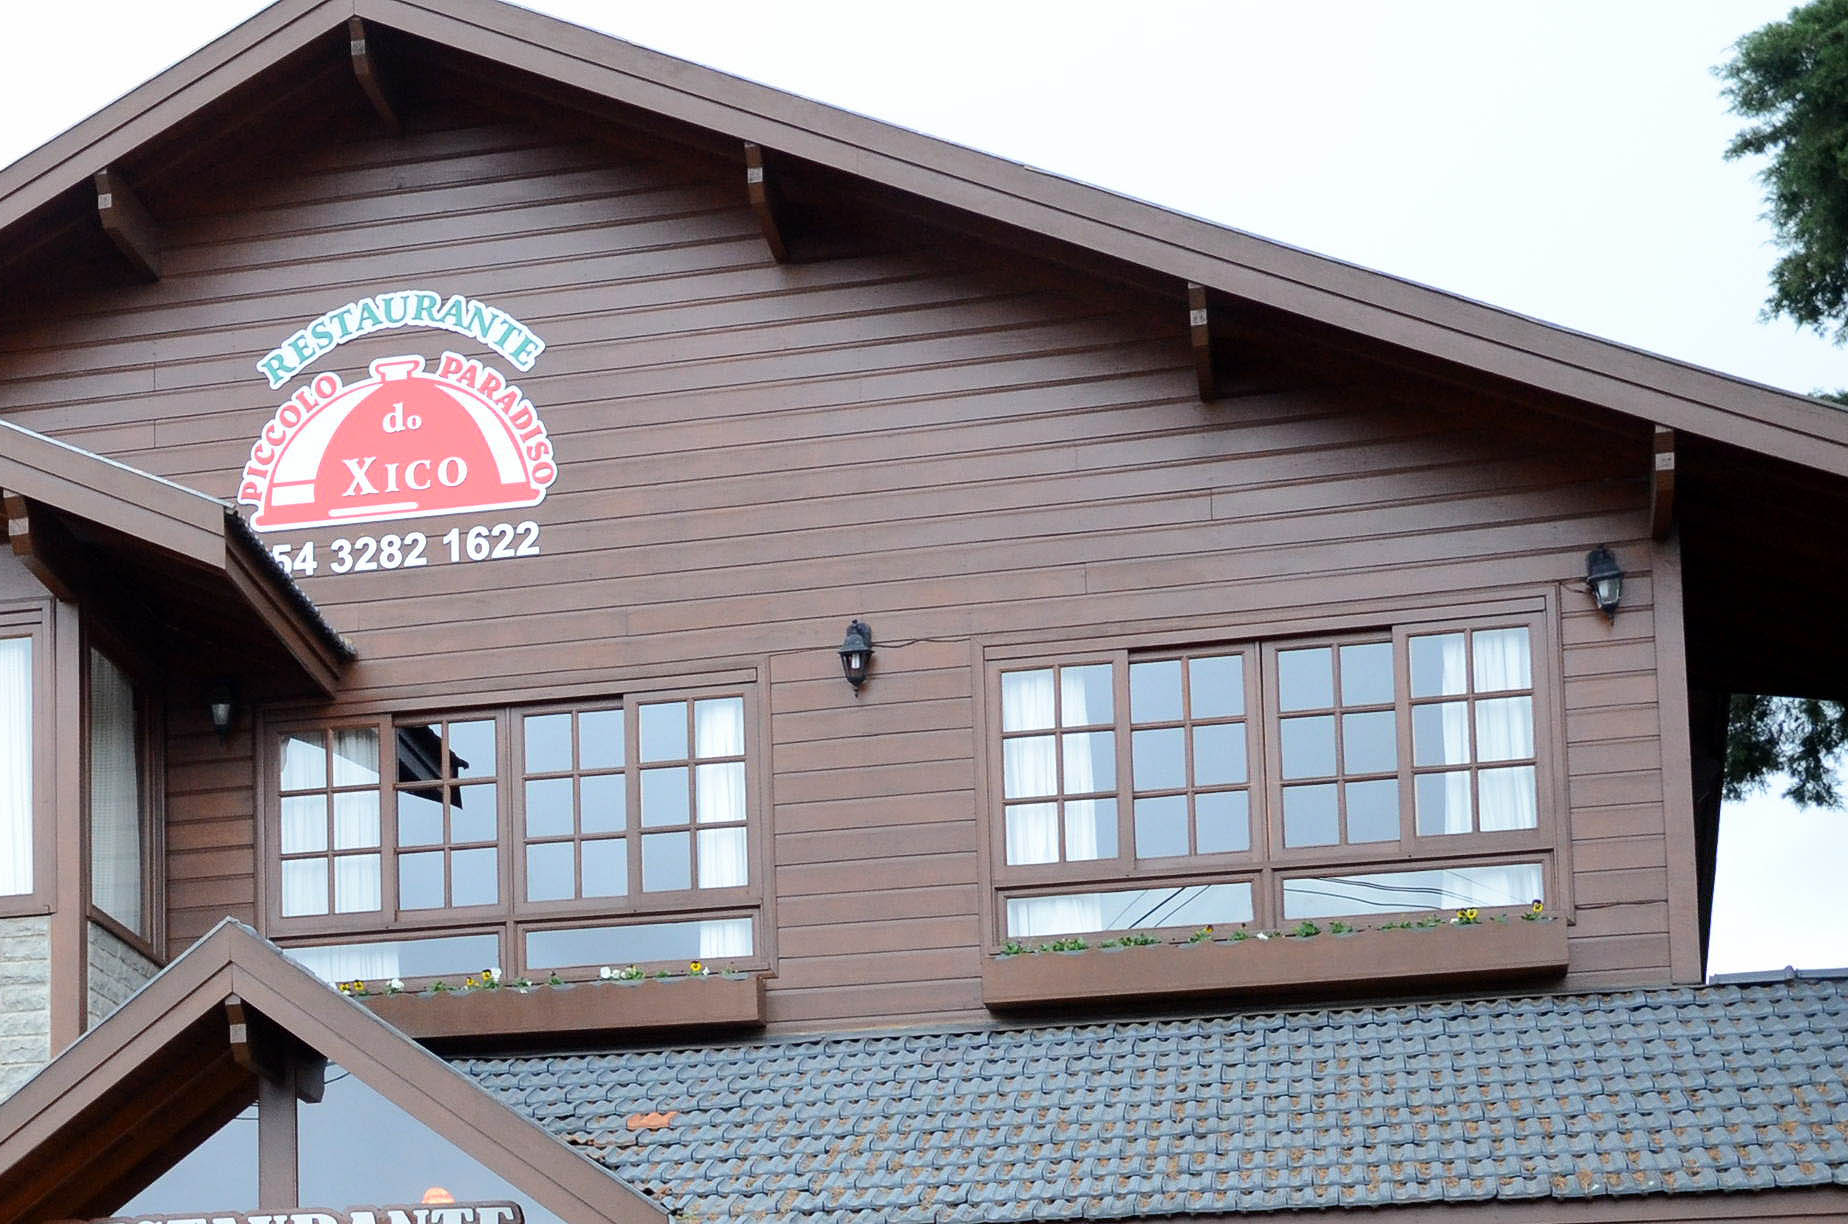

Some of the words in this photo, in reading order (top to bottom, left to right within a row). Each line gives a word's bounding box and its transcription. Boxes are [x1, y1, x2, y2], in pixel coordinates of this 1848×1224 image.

[261, 294, 543, 386] RESTAURANTE
[242, 374, 338, 502] PICCOLO
[439, 356, 555, 484] PARADISO
[382, 402, 422, 432] do
[272, 541, 318, 577] 54
[330, 532, 428, 574] 3282
[443, 521, 541, 563] 1622
